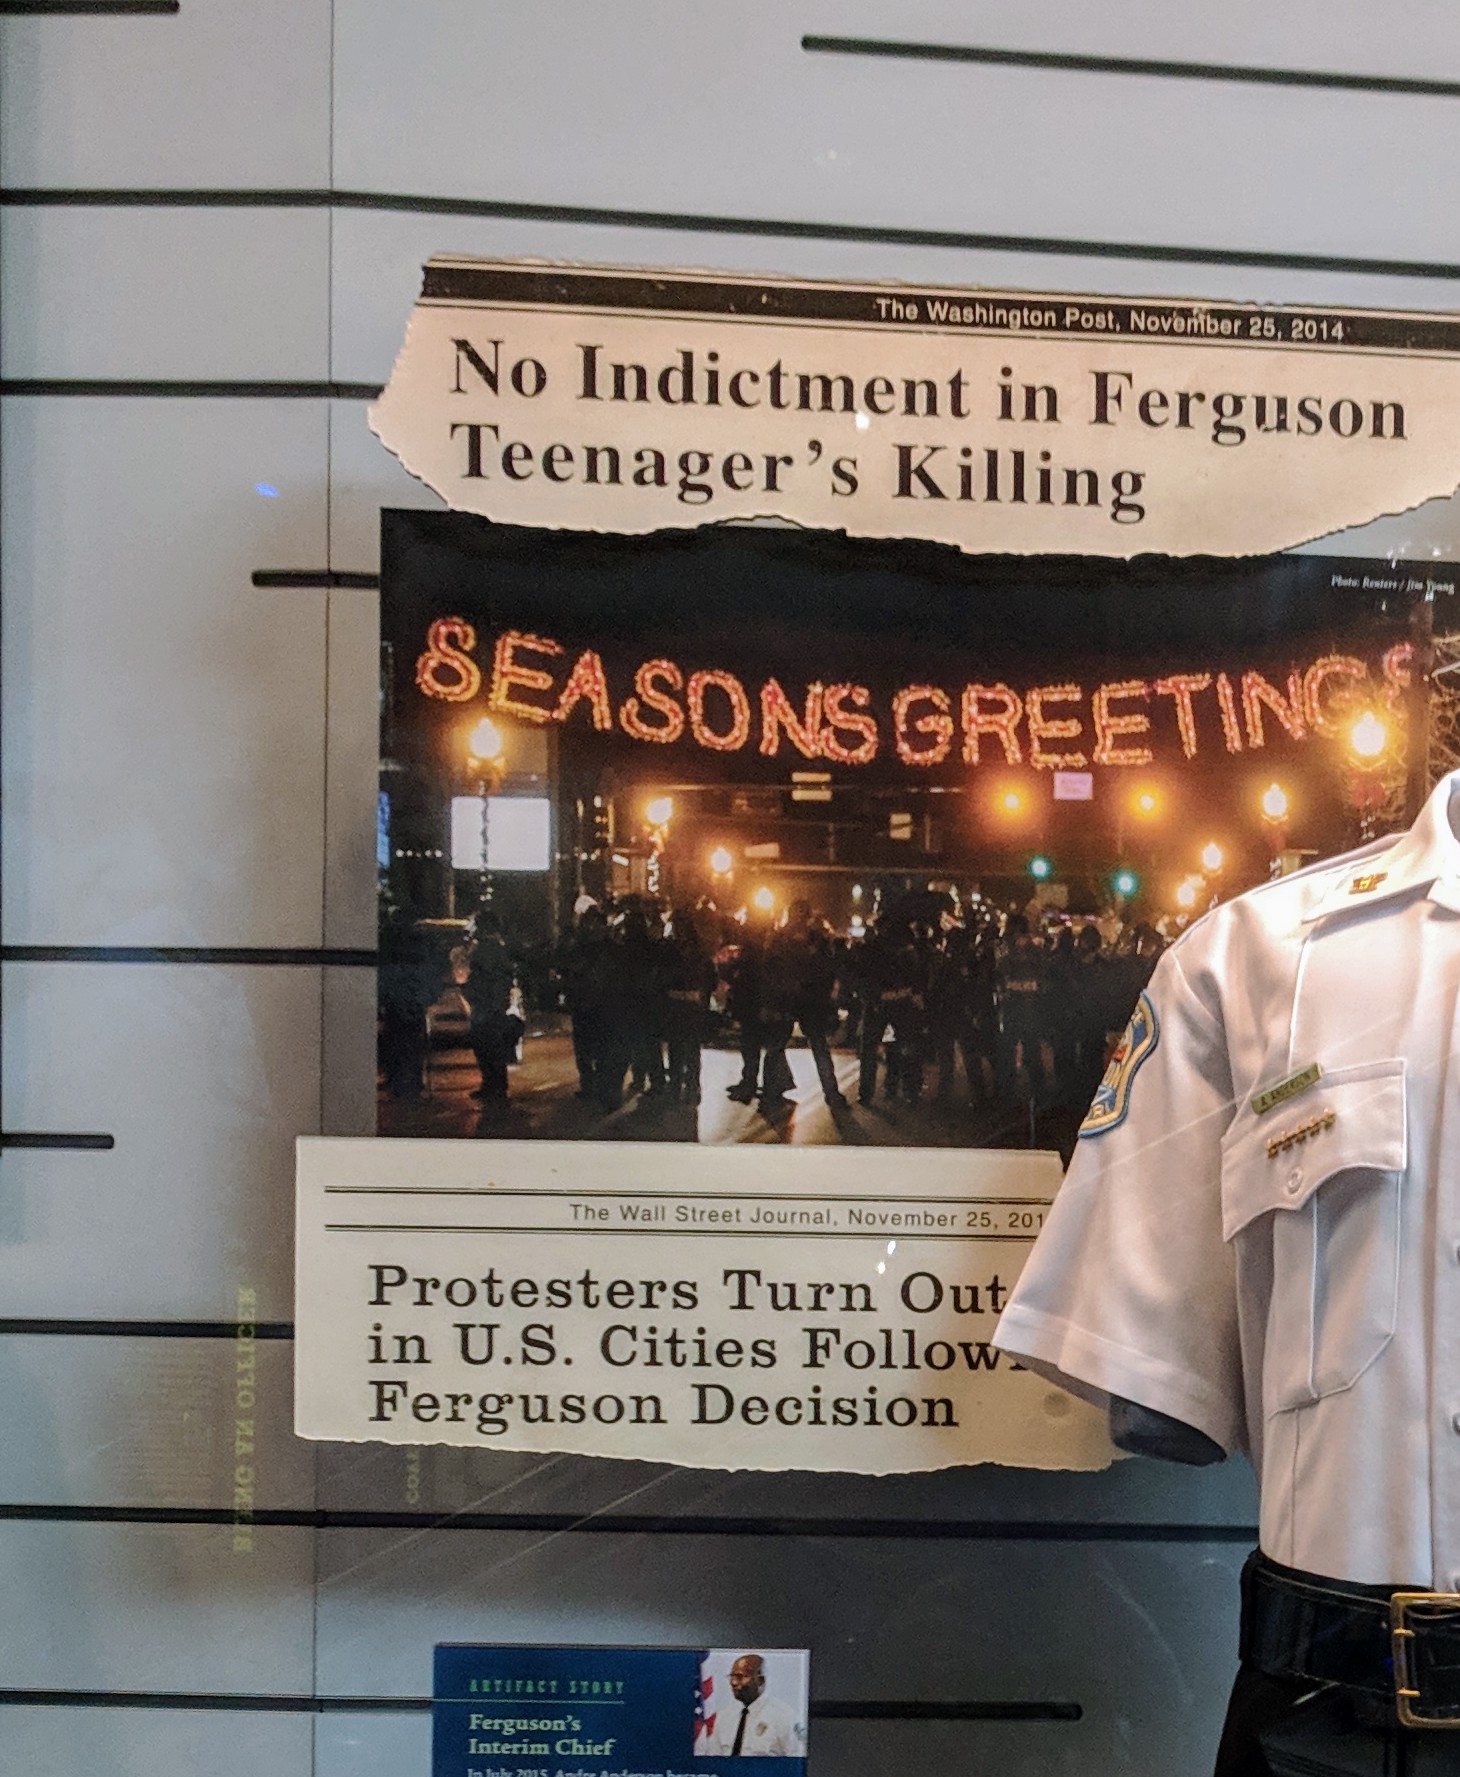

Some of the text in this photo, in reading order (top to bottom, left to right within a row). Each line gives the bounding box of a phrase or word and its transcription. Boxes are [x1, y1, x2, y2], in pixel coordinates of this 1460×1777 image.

[874, 299, 1344, 345] The Washington Post, November 25, 2014
[452, 338, 1406, 447] No Indictment in Ferguson
[450, 423, 1146, 524] Teenager's Killing
[416, 616, 878, 765] SEASONS
[569, 1203, 1044, 1231] The Wall Street Journal, November 25, 201
[368, 1264, 1007, 1315] Protesters Turn Out
[367, 1322, 998, 1371] in U.S. Cities Follow
[368, 1380, 960, 1436] Ferguson Decision
[470, 1679, 624, 1694] ARTIFACT STORY
[468, 1738, 616, 1756] Interim Chief
[469, 1713, 582, 1736] Ferguson's
